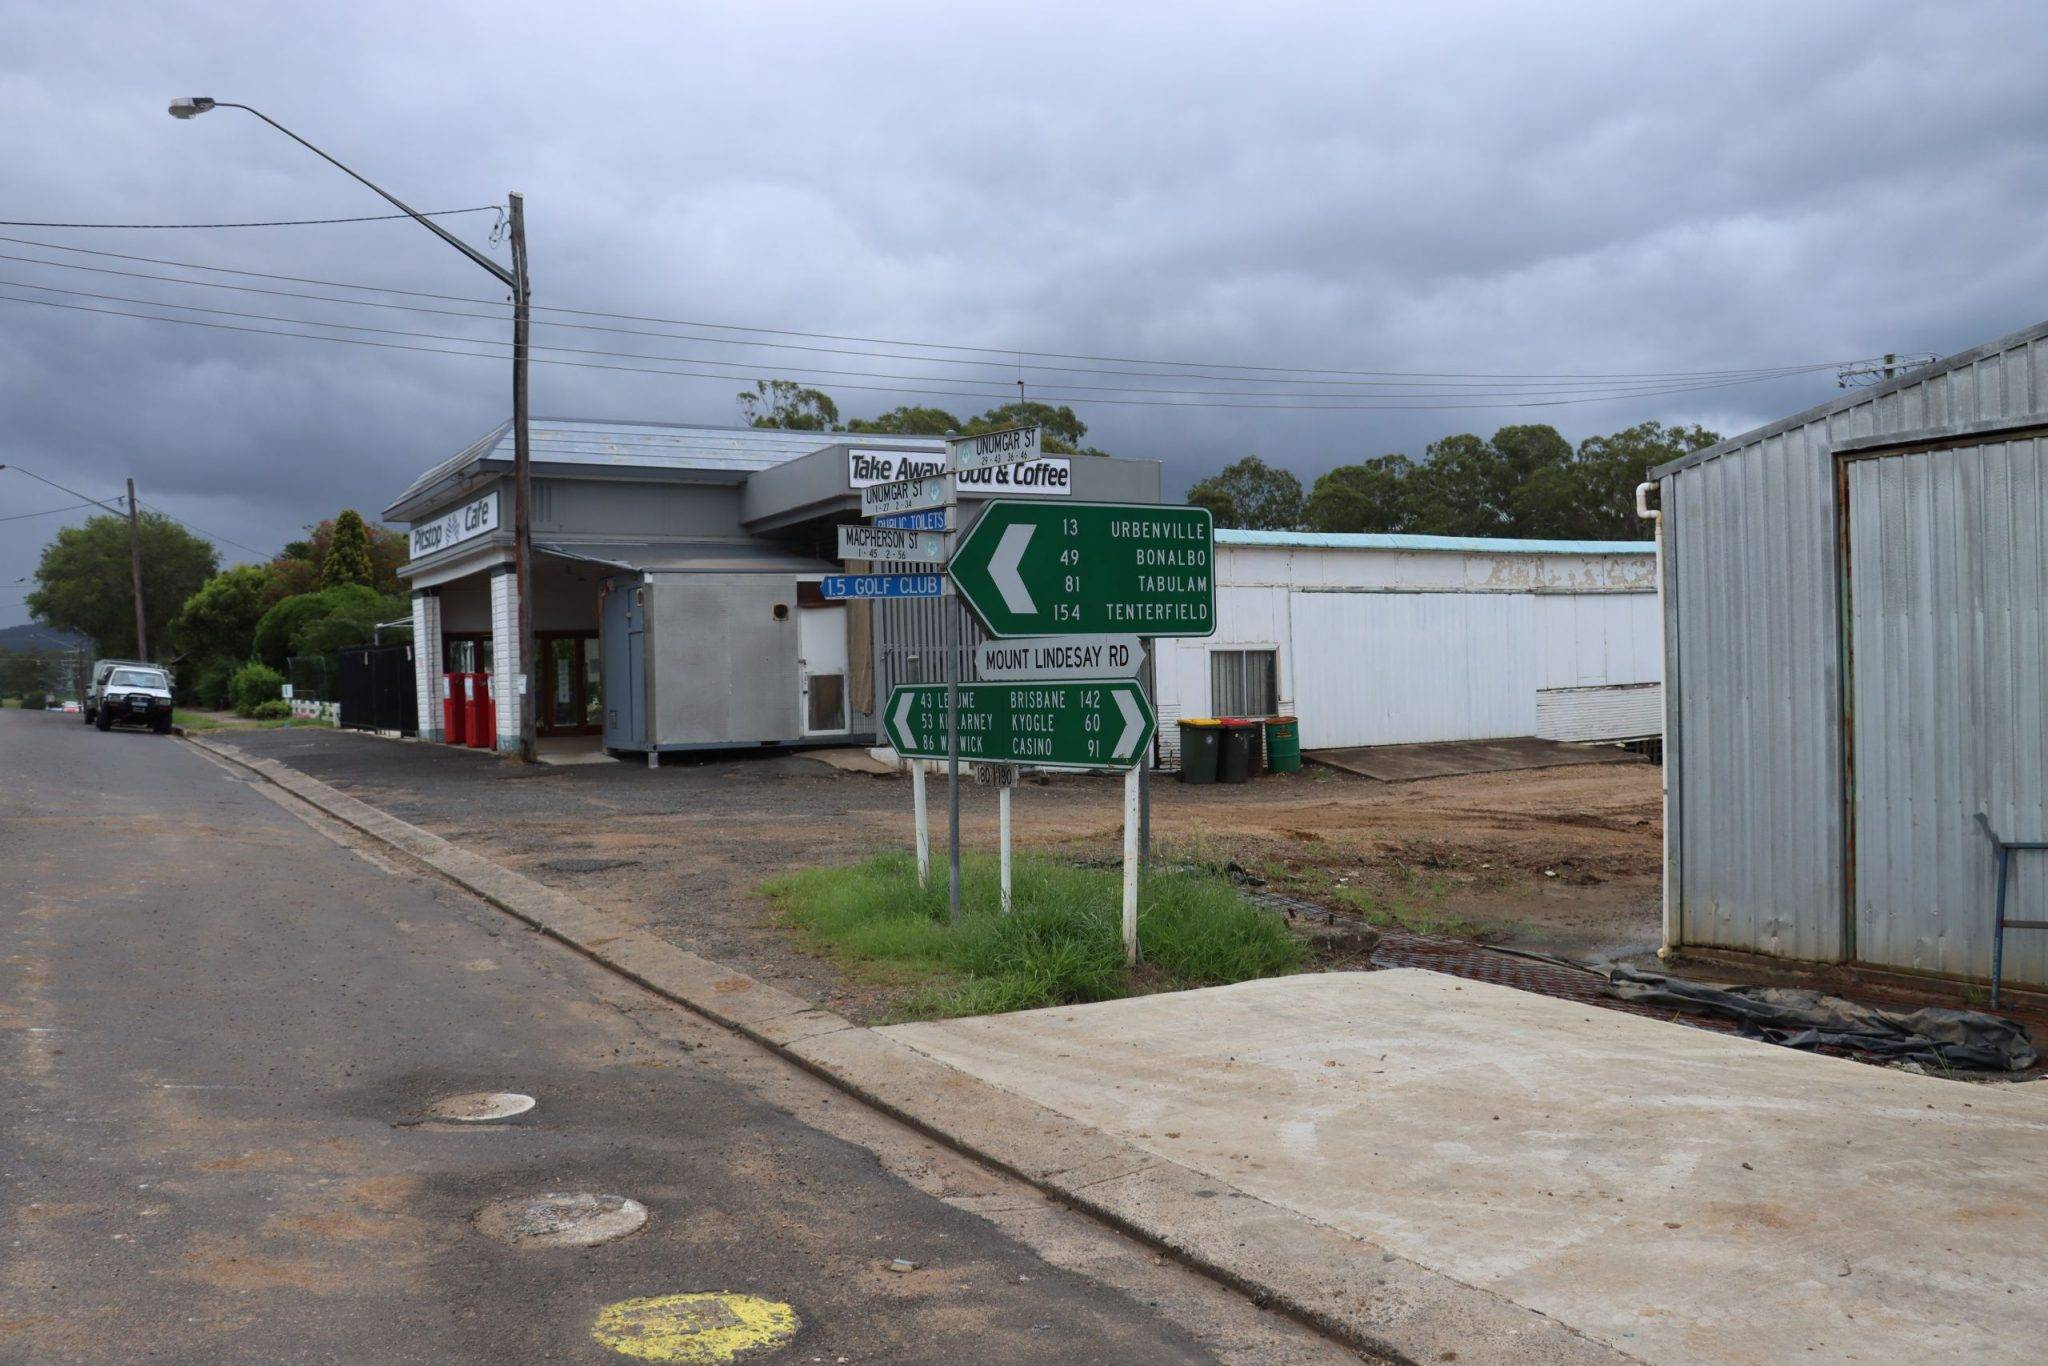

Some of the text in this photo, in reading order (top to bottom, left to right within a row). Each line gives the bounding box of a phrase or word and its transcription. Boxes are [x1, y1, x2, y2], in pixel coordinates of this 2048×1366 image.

[976, 429, 1036, 456] UNUMGAR ST
[852, 454, 1068, 487] Take Away ood & Coffee
[866, 479, 923, 504] UNUMGAR ST
[414, 500, 489, 553] Pitstop Cafe
[911, 512, 944, 529] TOILETS
[1062, 518, 1204, 540] 13 URBENVILLE
[846, 528, 919, 549] MACPHERSON ST
[1060, 549, 1205, 566] 49 BONALBO
[828, 575, 938, 596] 1.5 GOLF CLUB
[1065, 575, 1207, 593] 81 TABULAM
[1053, 602, 1208, 621] 154 TENTERFIELD
[986, 644, 1129, 670] MOUNT LINDESAY RD
[920, 692, 976, 710] 43 LEUME
[1010, 690, 1101, 709] BRISBANE 142
[921, 713, 993, 731] 53 KIARNEY
[1012, 713, 1101, 732] KYOGLE 60
[922, 735, 983, 753] 86 WWICK
[1012, 737, 1100, 758] CASINO 91
